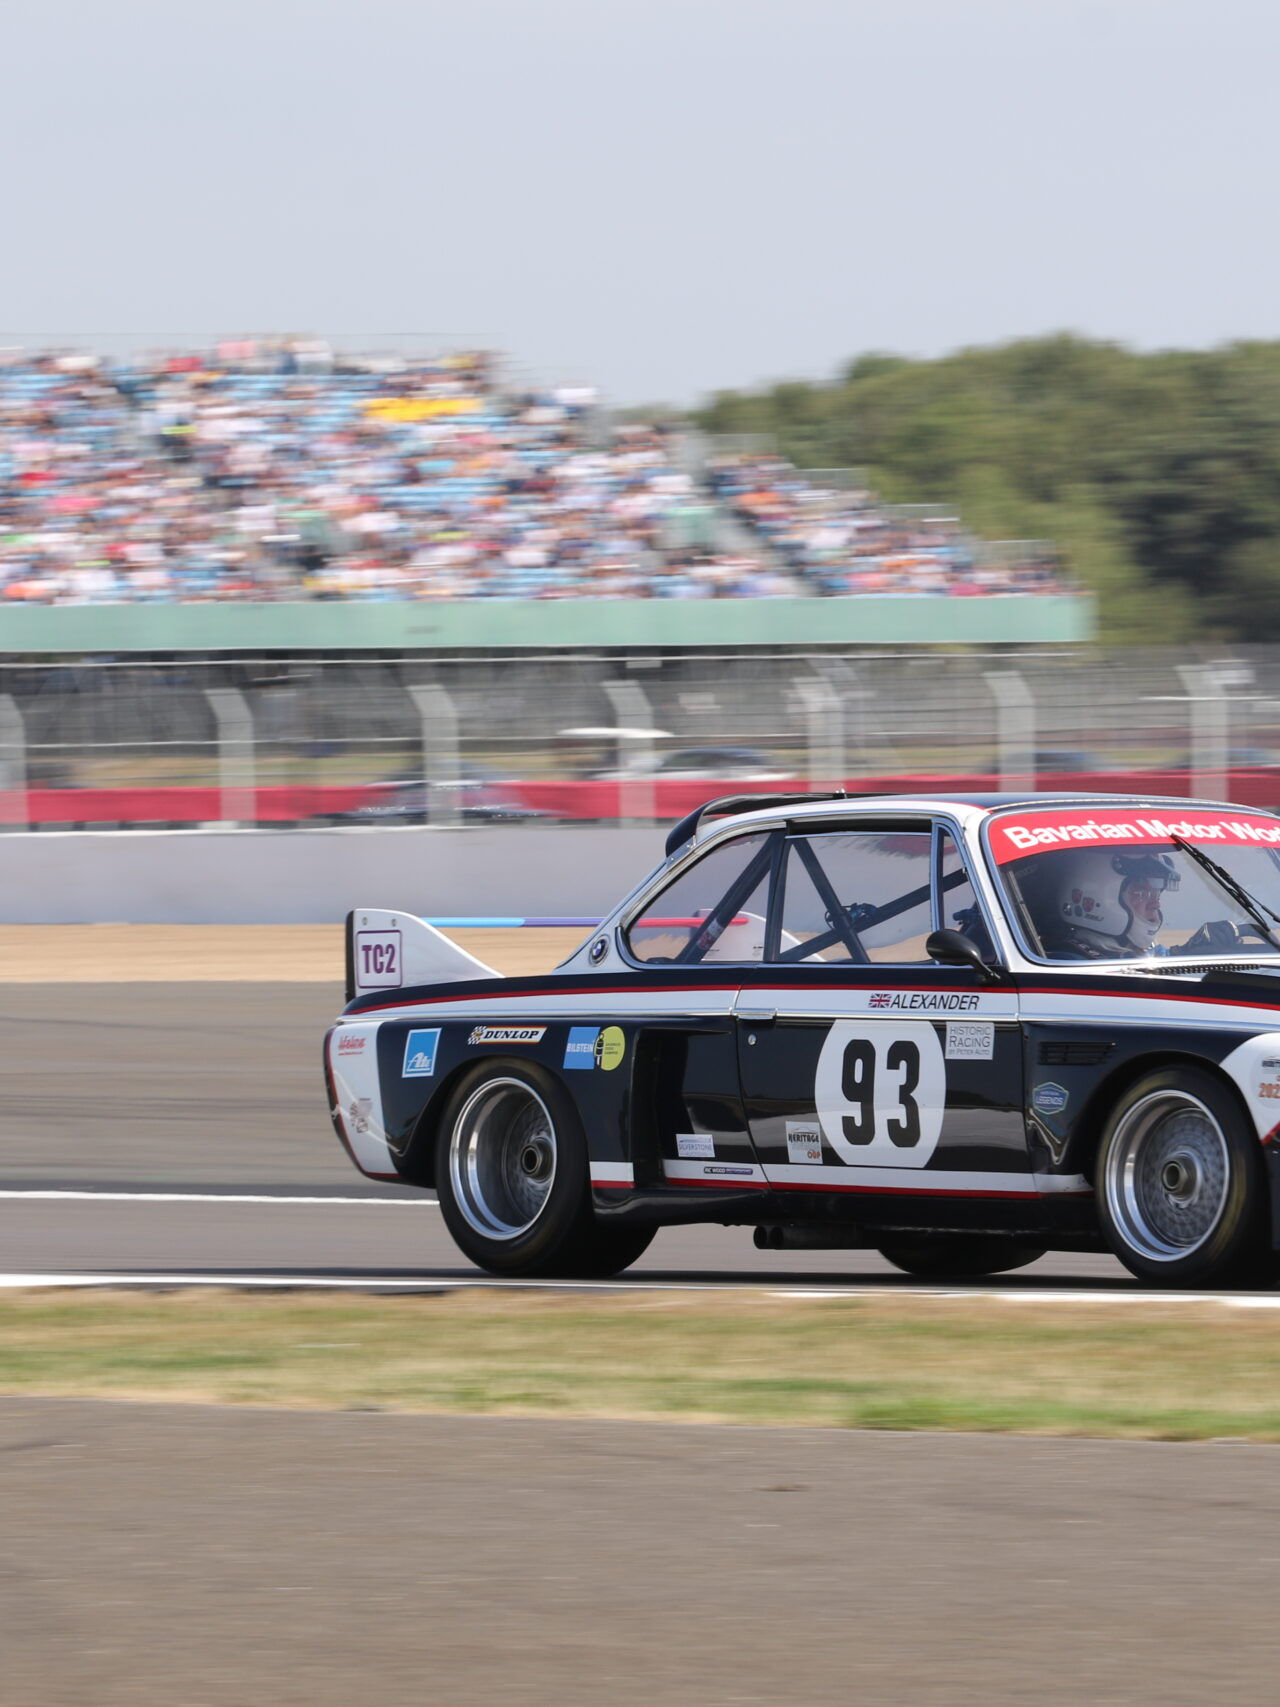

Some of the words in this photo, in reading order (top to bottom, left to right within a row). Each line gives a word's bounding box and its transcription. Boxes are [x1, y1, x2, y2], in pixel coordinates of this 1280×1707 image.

[1003, 820, 1134, 849] Bavarian
[1136, 819, 1225, 839] Motor
[361, 943, 396, 974] TC2
[890, 994, 980, 1010] ALEXANDER
[484, 1030, 539, 1039] DUNLOP
[949, 1026, 991, 1036] HISTORIC
[566, 1043, 594, 1053] BILSTEIN
[949, 1035, 991, 1048] RACING
[841, 1039, 921, 1148] 93
[788, 1132, 820, 1143] HERITAGE
